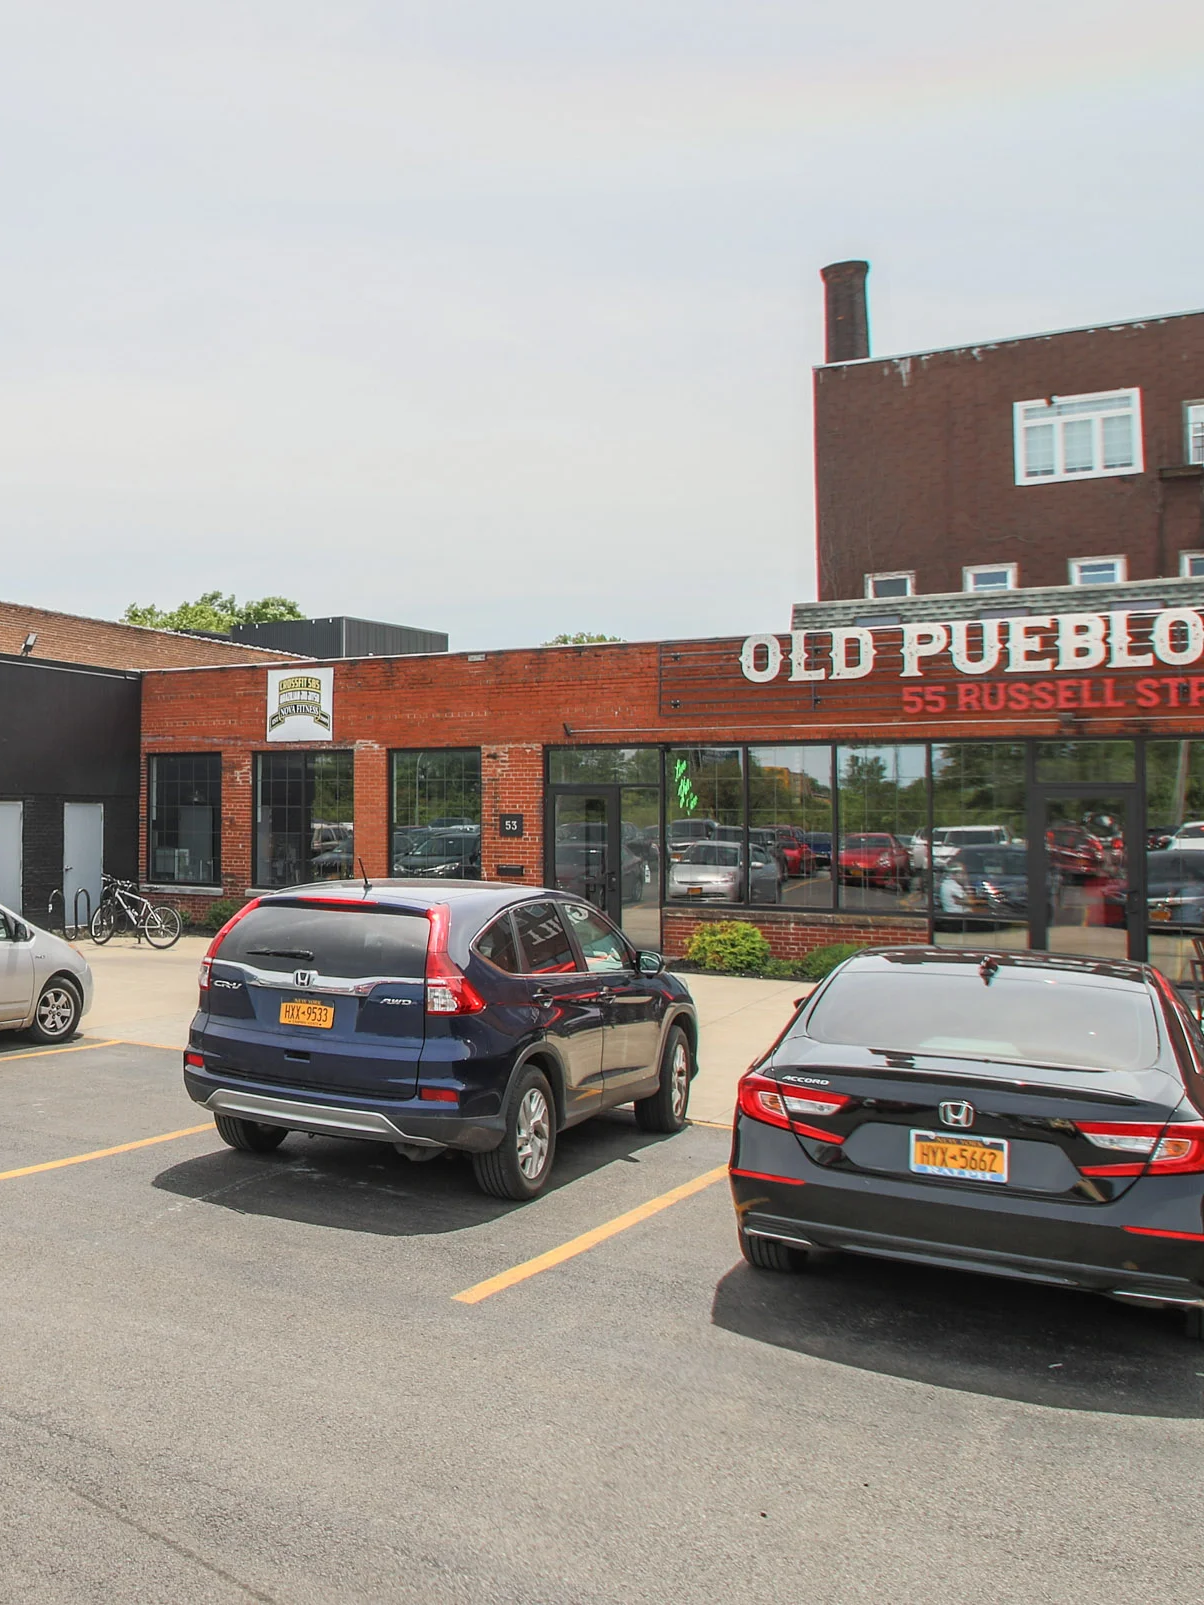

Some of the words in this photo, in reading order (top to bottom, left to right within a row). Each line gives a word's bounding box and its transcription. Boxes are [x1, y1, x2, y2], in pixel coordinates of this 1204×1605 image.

[738, 627, 877, 683] OLD
[899, 608, 1204, 677] PUEBLO
[279, 677, 307, 690] CROSSFIT
[901, 685, 946, 714] 55
[956, 678, 1125, 712] RUSSELL
[280, 705, 295, 717] NOVA
[296, 704, 319, 716] FITNESS
[505, 820, 517, 830] 53
[379, 998, 412, 1006] AWD
[782, 1075, 831, 1086] ACCORD
